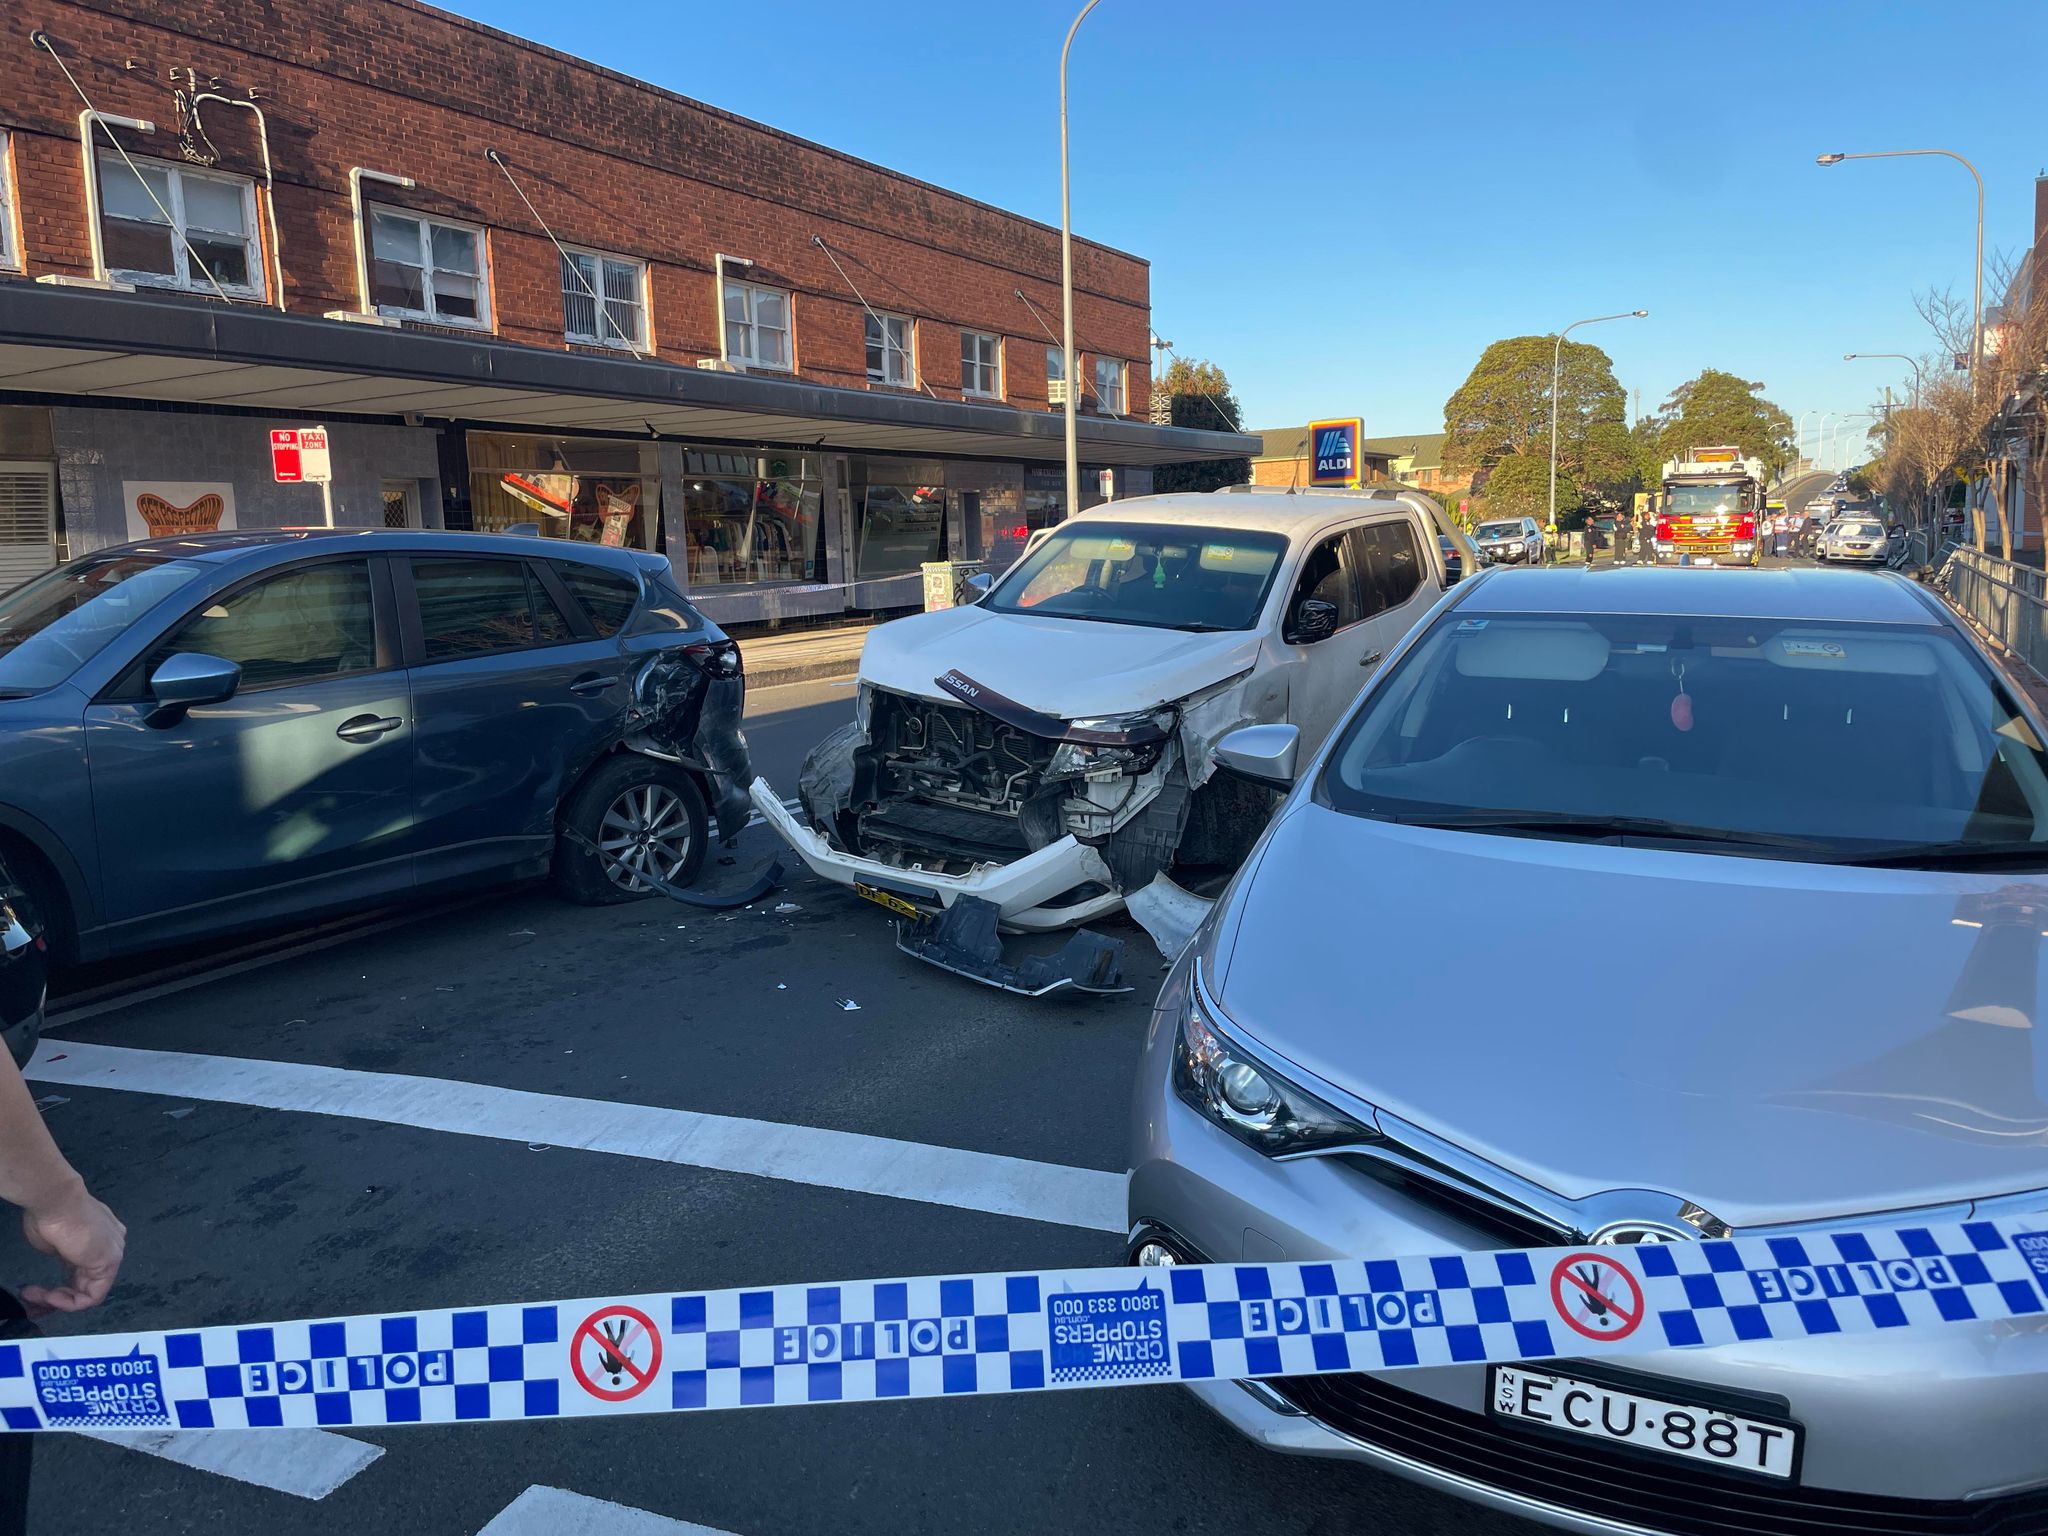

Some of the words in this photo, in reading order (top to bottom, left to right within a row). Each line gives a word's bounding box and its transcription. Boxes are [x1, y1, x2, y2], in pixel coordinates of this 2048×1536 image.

[279, 432, 291, 442] NO
[303, 433, 324, 441] TAXI
[304, 441, 324, 449] ZONE
[273, 442, 299, 450] STOPPING
[1318, 457, 1351, 471] ALDI
[1758, 1258, 1951, 1299] POLICE
[1053, 1299, 1084, 1316] 000
[1088, 1298, 1117, 1314] 333
[1121, 1295, 1160, 1312] 1800
[1054, 1315, 1091, 1324] .com.au
[1247, 1293, 1437, 1332] POLICE
[783, 1319, 969, 1360] POLICE
[1054, 1319, 1162, 1344] STOPPERS
[1092, 1340, 1164, 1363] CRIME
[38, 1365, 71, 1380] 000
[75, 1363, 107, 1378] 333
[111, 1360, 153, 1376] 1800
[250, 1352, 447, 1392] POLICE
[41, 1382, 157, 1403] STOPPERS
[1499, 1373, 1515, 1413] NSW
[84, 1399, 160, 1415] CRIME
